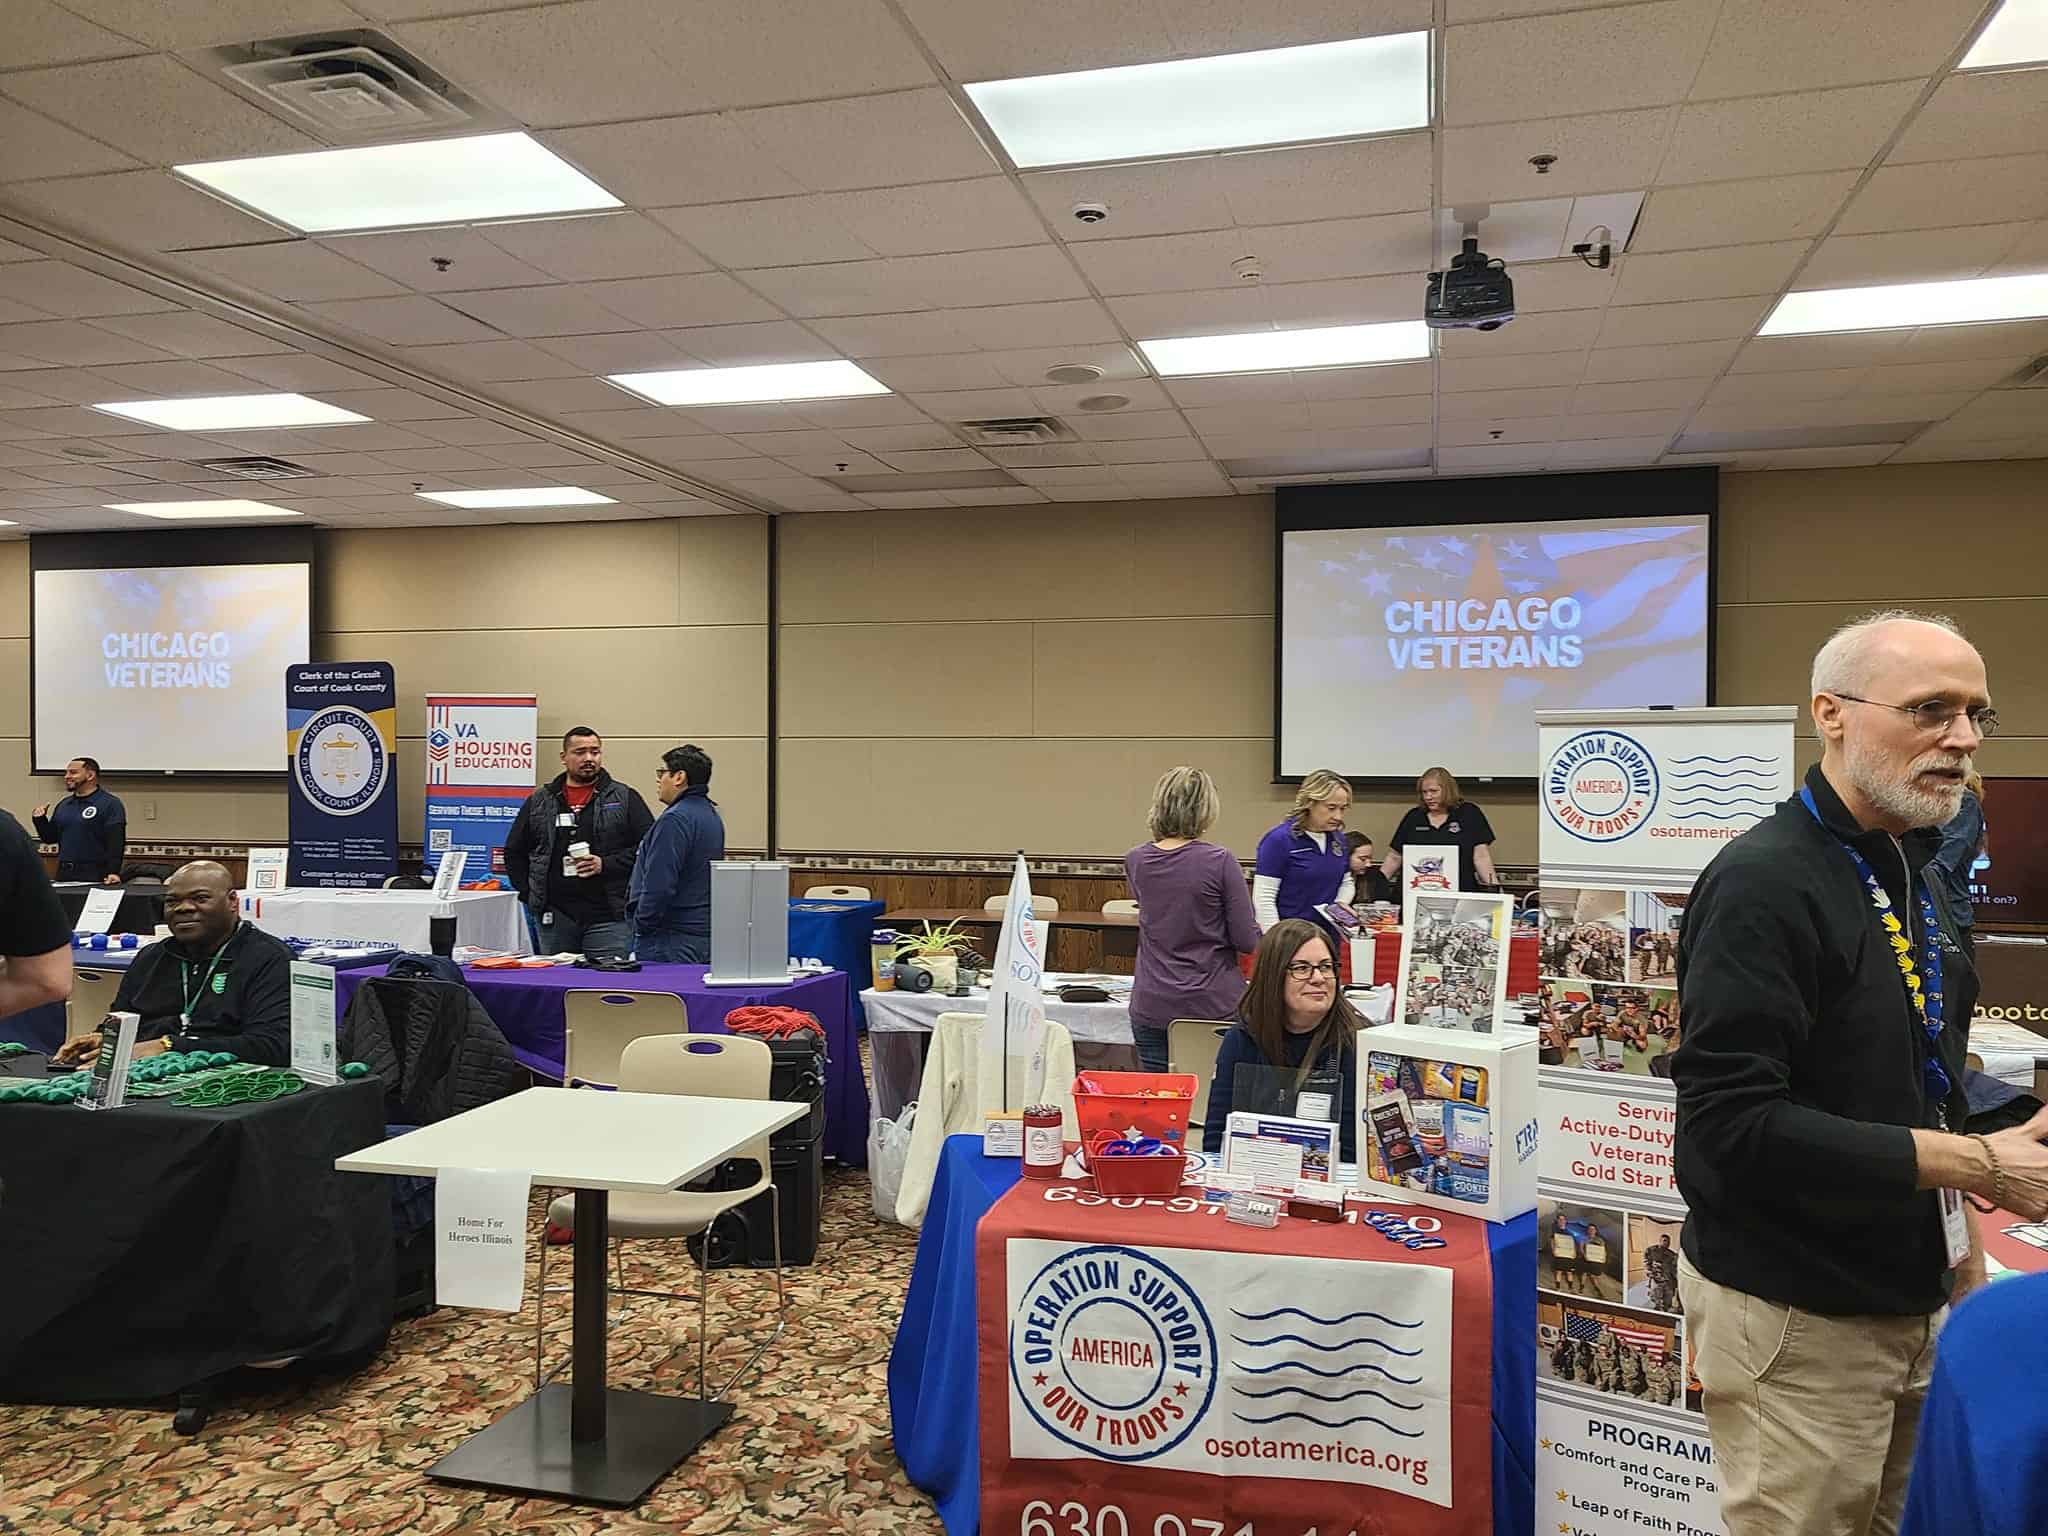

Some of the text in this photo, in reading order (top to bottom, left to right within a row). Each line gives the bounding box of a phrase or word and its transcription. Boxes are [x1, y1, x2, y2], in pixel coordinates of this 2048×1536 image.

[1384, 597, 1582, 633] CHICAGO
[102, 632, 230, 658] CHICAGO
[1387, 635, 1584, 669] VETERANS
[104, 662, 231, 688] VETERANS
[293, 683, 387, 693] Court of Cook County
[299, 670, 381, 680] Clerk of the Circuit
[304, 713, 377, 744] CIRCUIT COURT
[454, 723, 479, 738] VA
[455, 741, 532, 756] HOUSING
[455, 757, 532, 769] EDUCATION
[1551, 738, 1650, 797] OPERATION SUPPORT
[1575, 780, 1624, 794] AMERICA
[1559, 805, 1640, 835] OUR TROOPS
[1571, 1160, 1616, 1181] Gold
[1622, 1167, 1662, 1188] Star
[457, 1216, 504, 1228] Home For
[448, 1231, 513, 1245] Heroes Illinois
[1025, 1260, 1202, 1378] OPERATION SUPPORT
[1071, 1337, 1154, 1369] AMERICA
[1043, 1386, 1184, 1446] OUR TROOPS
[1588, 1419, 1715, 1464] PROGRAM
[1205, 1437, 1428, 1486] osotamerica.org
[1554, 1442, 1718, 1493] Comfort and Care Pa
[1624, 1476, 1690, 1503] Program
[1572, 1495, 1609, 1517] Leap
[1613, 1508, 1629, 1520] of
[1633, 1511, 1672, 1532] Faith
